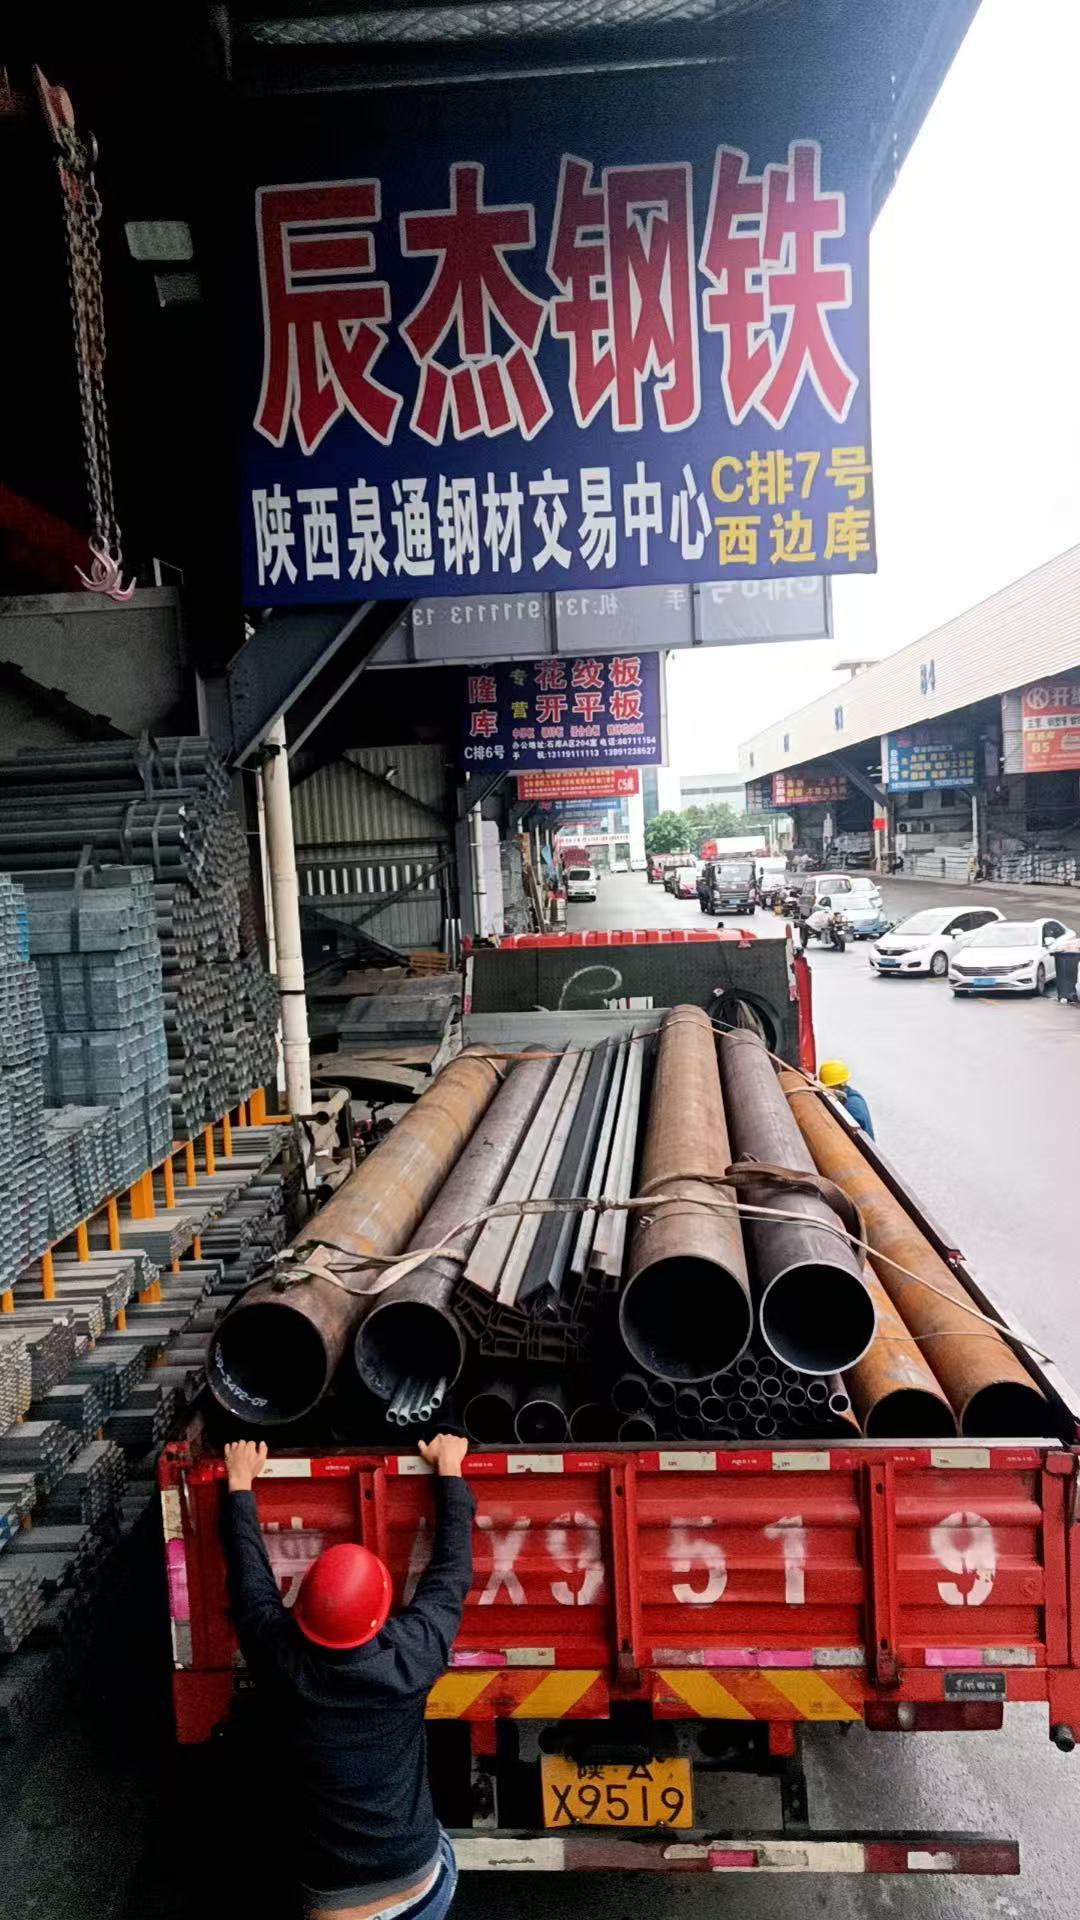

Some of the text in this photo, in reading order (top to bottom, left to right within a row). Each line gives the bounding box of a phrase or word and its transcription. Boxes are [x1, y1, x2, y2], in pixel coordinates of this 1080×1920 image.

[254, 140, 859, 455] 辰杰钢铁
[711, 446, 872, 505] C排7号
[252, 461, 713, 586] 陕西泉通钢材交易中心
[715, 506, 871, 565] 西边库
[534, 656, 643, 691] 花纹板
[535, 690, 643, 724] 开平板
[463, 744, 505, 761] C排6号
[551, 1784, 684, 1822] X9519
